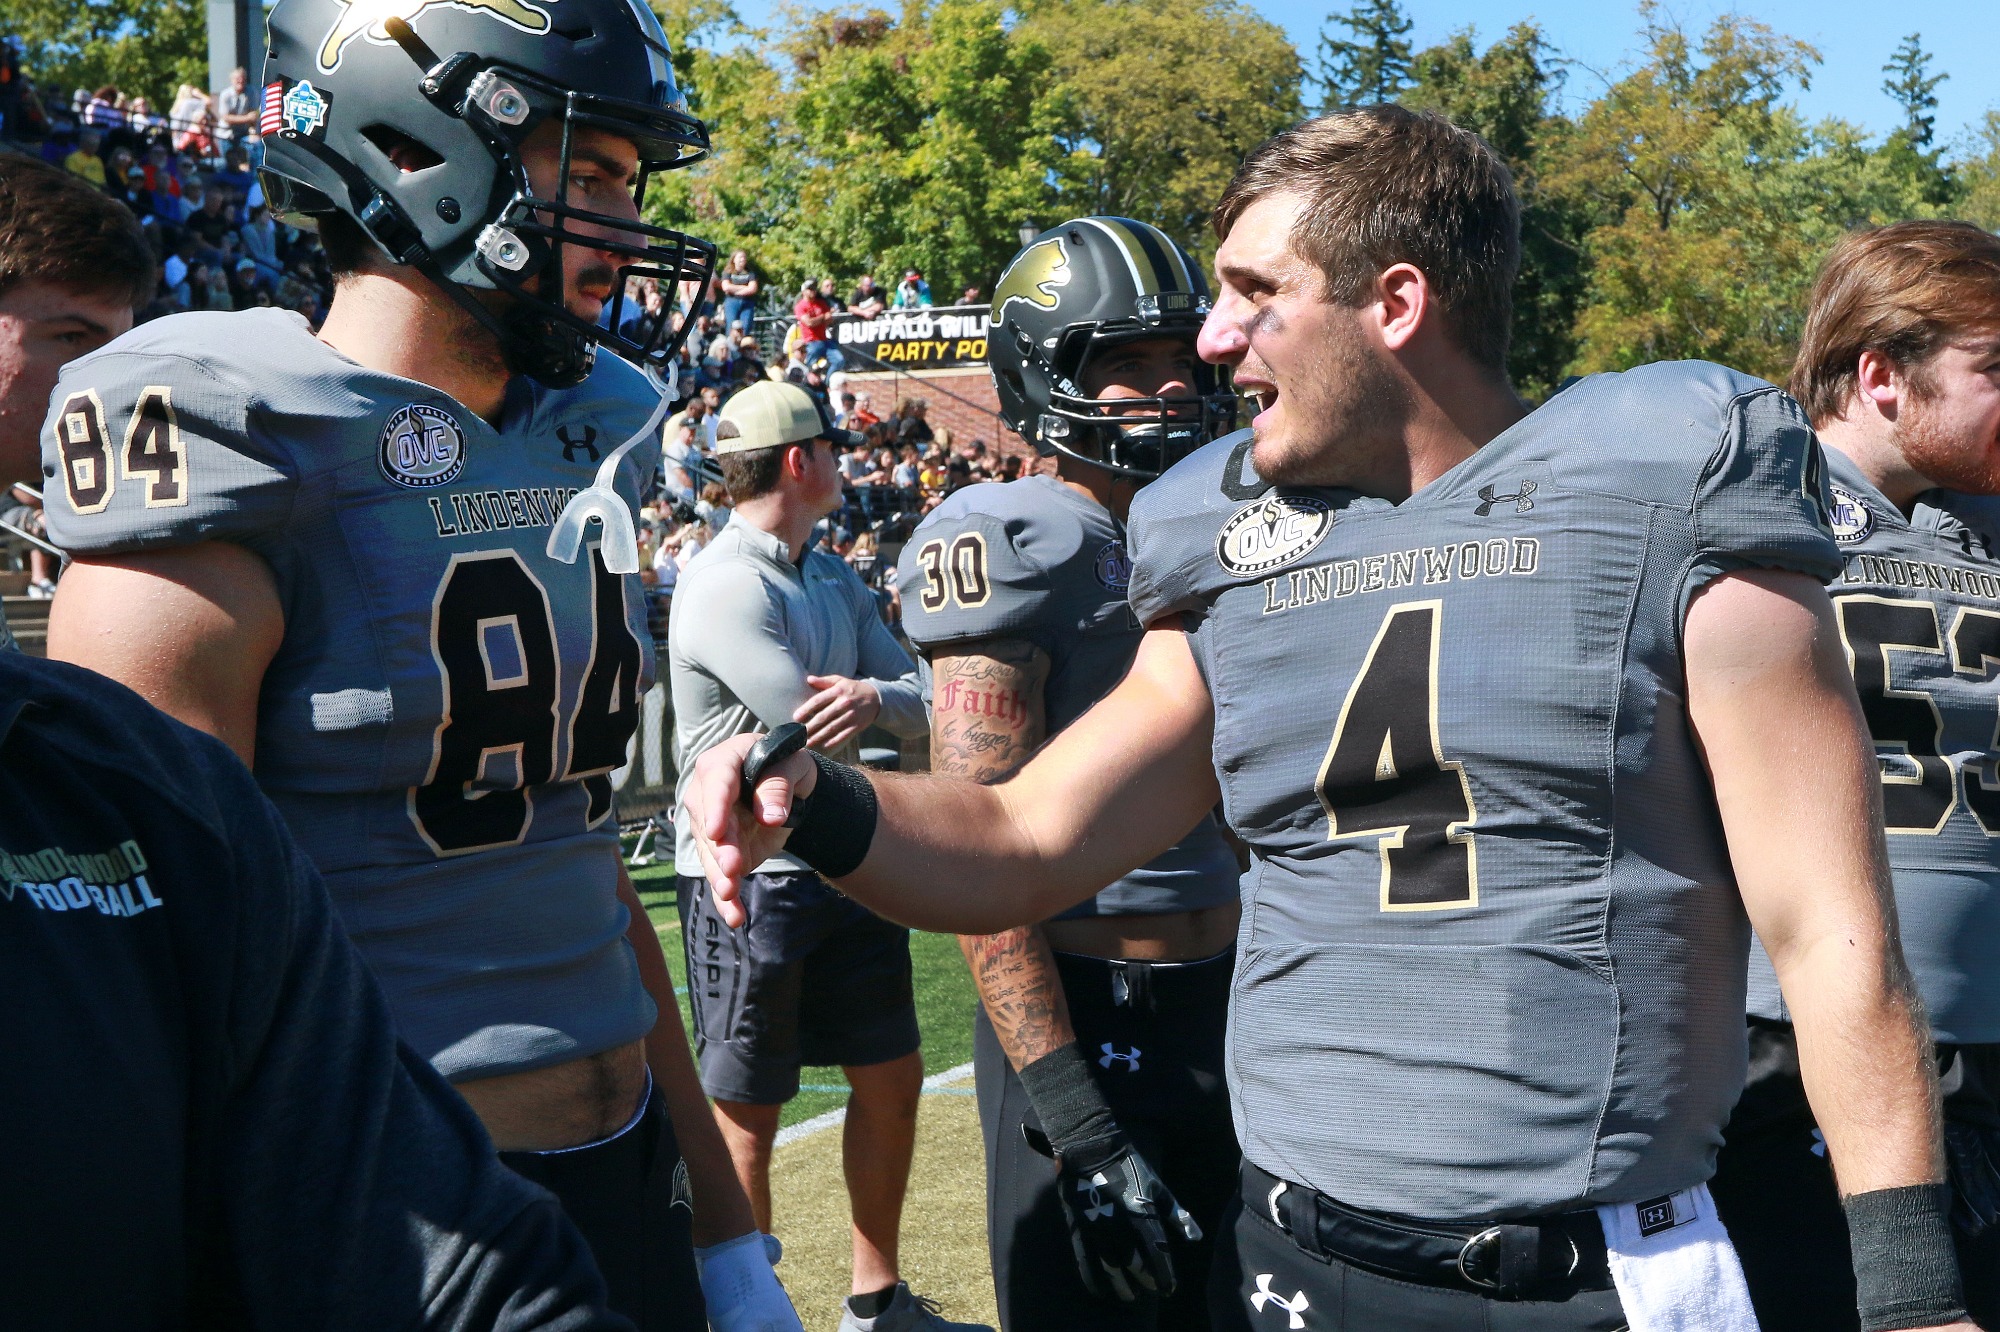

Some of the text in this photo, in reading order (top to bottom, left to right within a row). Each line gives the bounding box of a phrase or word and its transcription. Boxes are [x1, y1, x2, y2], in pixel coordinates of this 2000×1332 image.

[290, 101, 318, 117] FCS
[1167, 295, 1189, 309] LIONS
[838, 312, 934, 344] BUFFALO
[876, 341, 949, 361] PARTY
[54, 385, 188, 515] 84
[397, 424, 453, 470] OVC
[428, 486, 602, 537] LINDENW
[1239, 508, 1305, 558] OVC
[1828, 503, 1858, 528] VC
[916, 531, 992, 613] 30
[1105, 556, 1134, 582] OV
[1262, 537, 1540, 615] LINDENWOOD
[1842, 553, 2000, 600] LINDENWOO
[406, 540, 644, 858] 84
[938, 679, 1027, 730] Faith
[1314, 598, 1479, 912] 4
[23, 874, 163, 917] FOOBALL
